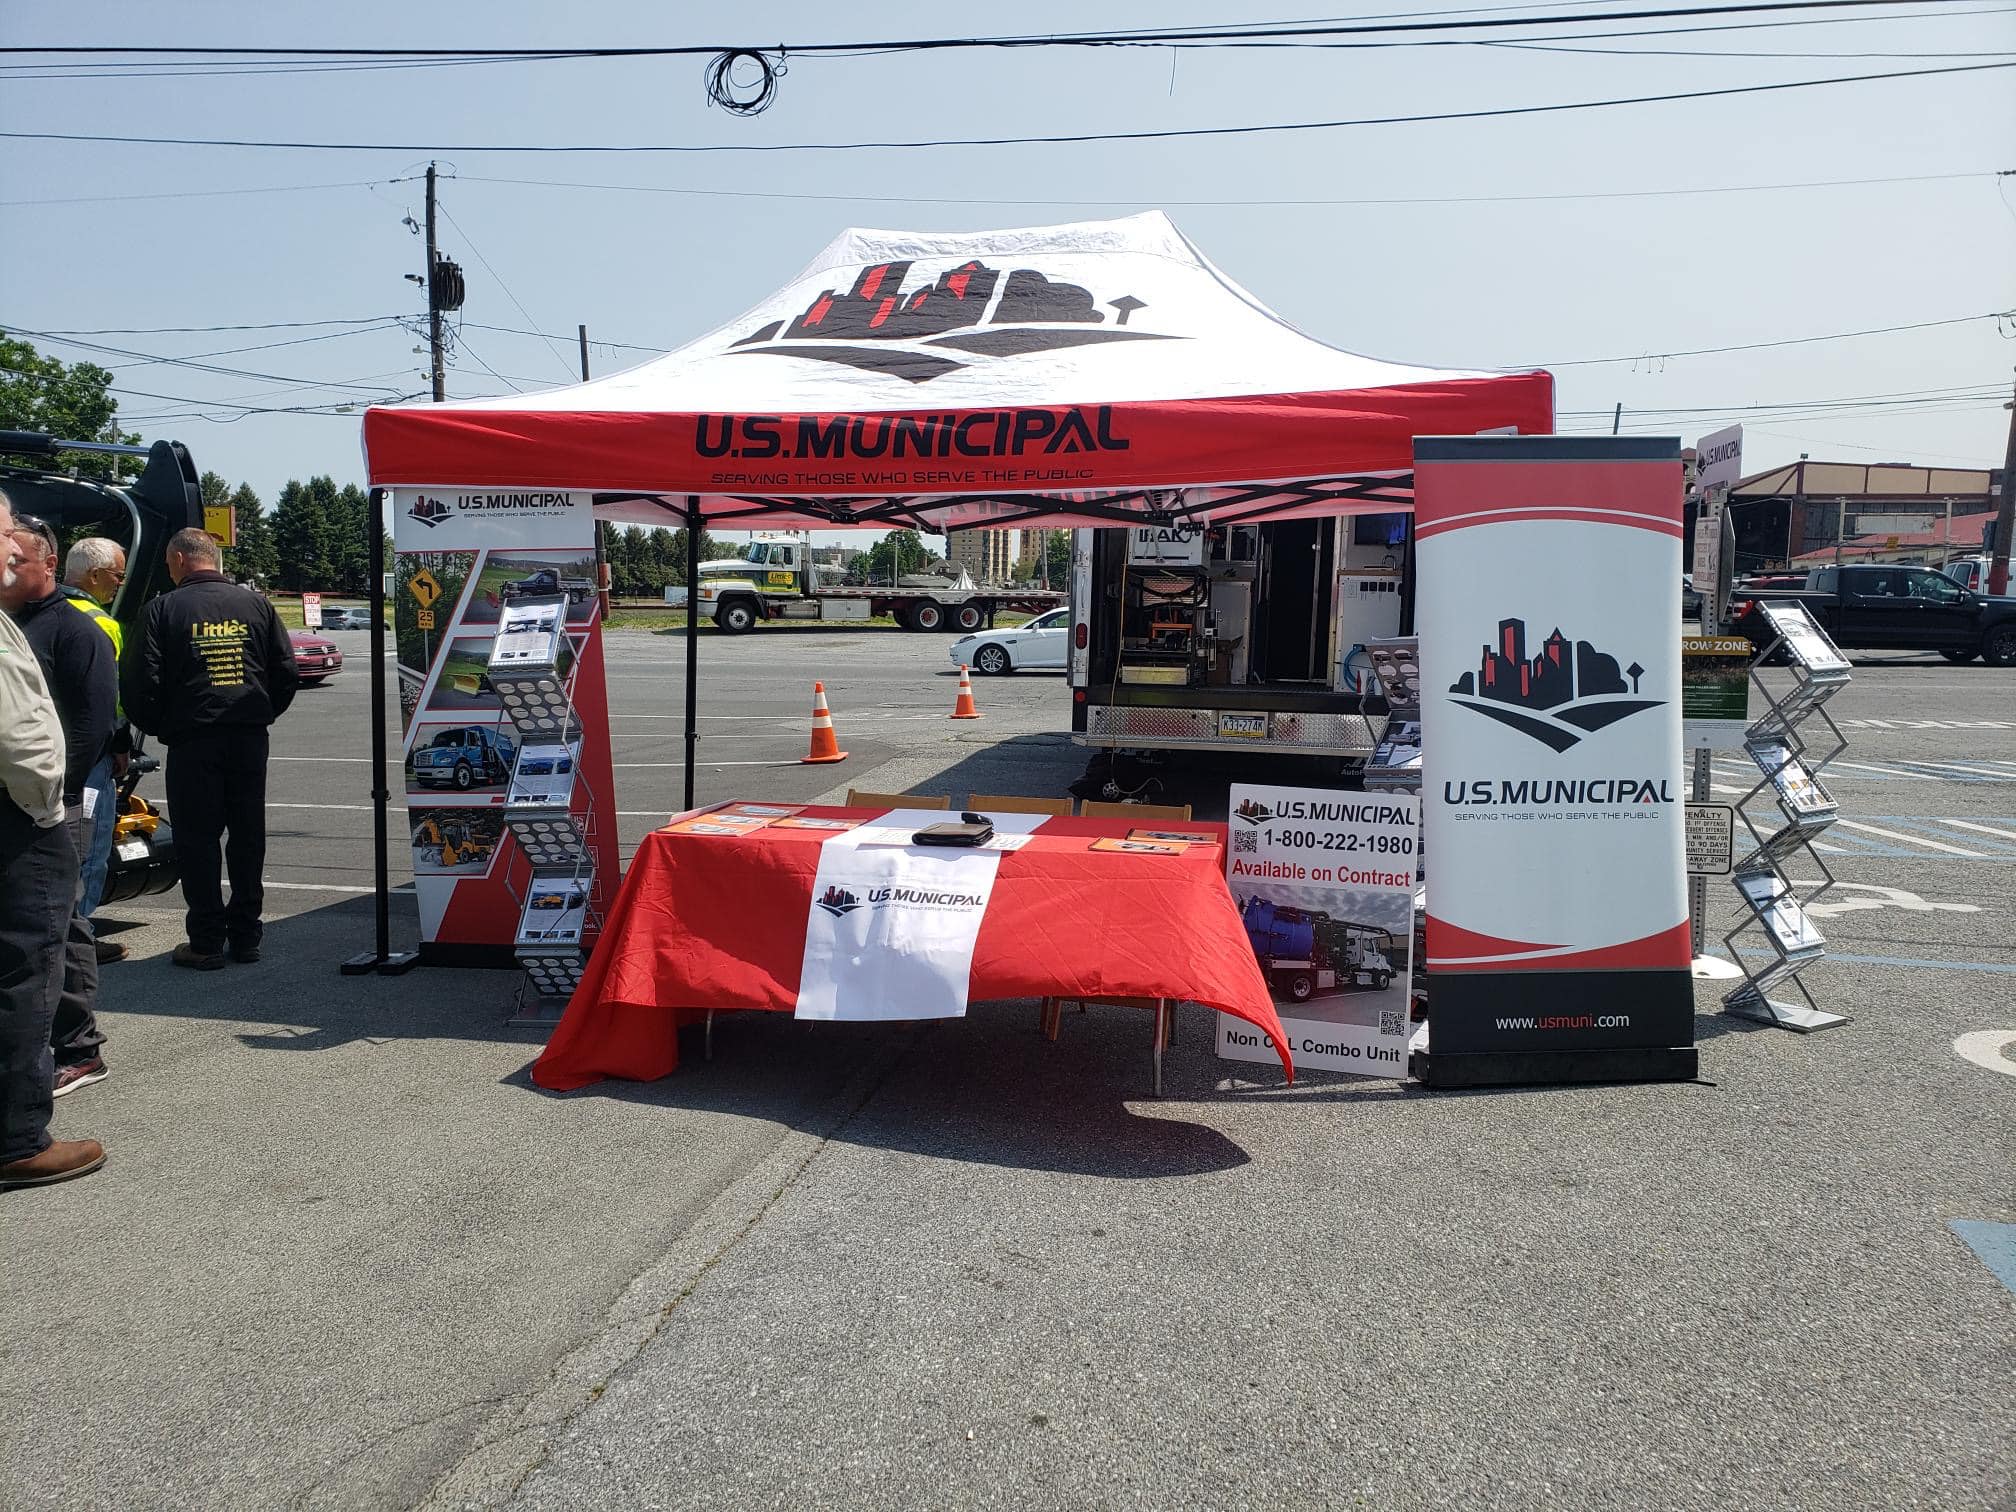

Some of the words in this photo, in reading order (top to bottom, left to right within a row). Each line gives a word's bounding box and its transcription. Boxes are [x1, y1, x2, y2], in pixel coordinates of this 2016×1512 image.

[695, 405, 1130, 458] U.S.MUNICIPAL
[711, 473, 789, 485] SERVING
[795, 473, 857, 485] THOSE
[862, 472, 907, 484] WHO
[913, 471, 976, 483] SERVE
[982, 470, 1018, 481] THE
[1024, 469, 1094, 480] PUBLIC
[458, 493, 574, 510] U.S.MUNICIPAL
[305, 595, 320, 604] STOP
[420, 611, 433, 622] 25
[1714, 641, 1749, 651] ZONE
[1444, 779, 1675, 805] U.S.MUNICIPAL
[1276, 801, 1416, 826] U.S.MUNICIPAL
[1454, 813, 1498, 821] SERVING
[1565, 812, 1599, 820] SERVE
[1623, 811, 1659, 819] PUBLIC
[1264, 829, 1413, 855] 1-800-222-1980
[1232, 858, 1306, 880] Available
[1311, 868, 1332, 881] on
[1337, 866, 1410, 887] Contract
[1496, 1013, 1630, 1029] www.usmuni.com
[1227, 1031, 1258, 1047] Non
[1264, 1036, 1297, 1051] CL
[1302, 1040, 1361, 1058] Combo
[1366, 1046, 1401, 1062] Unit
